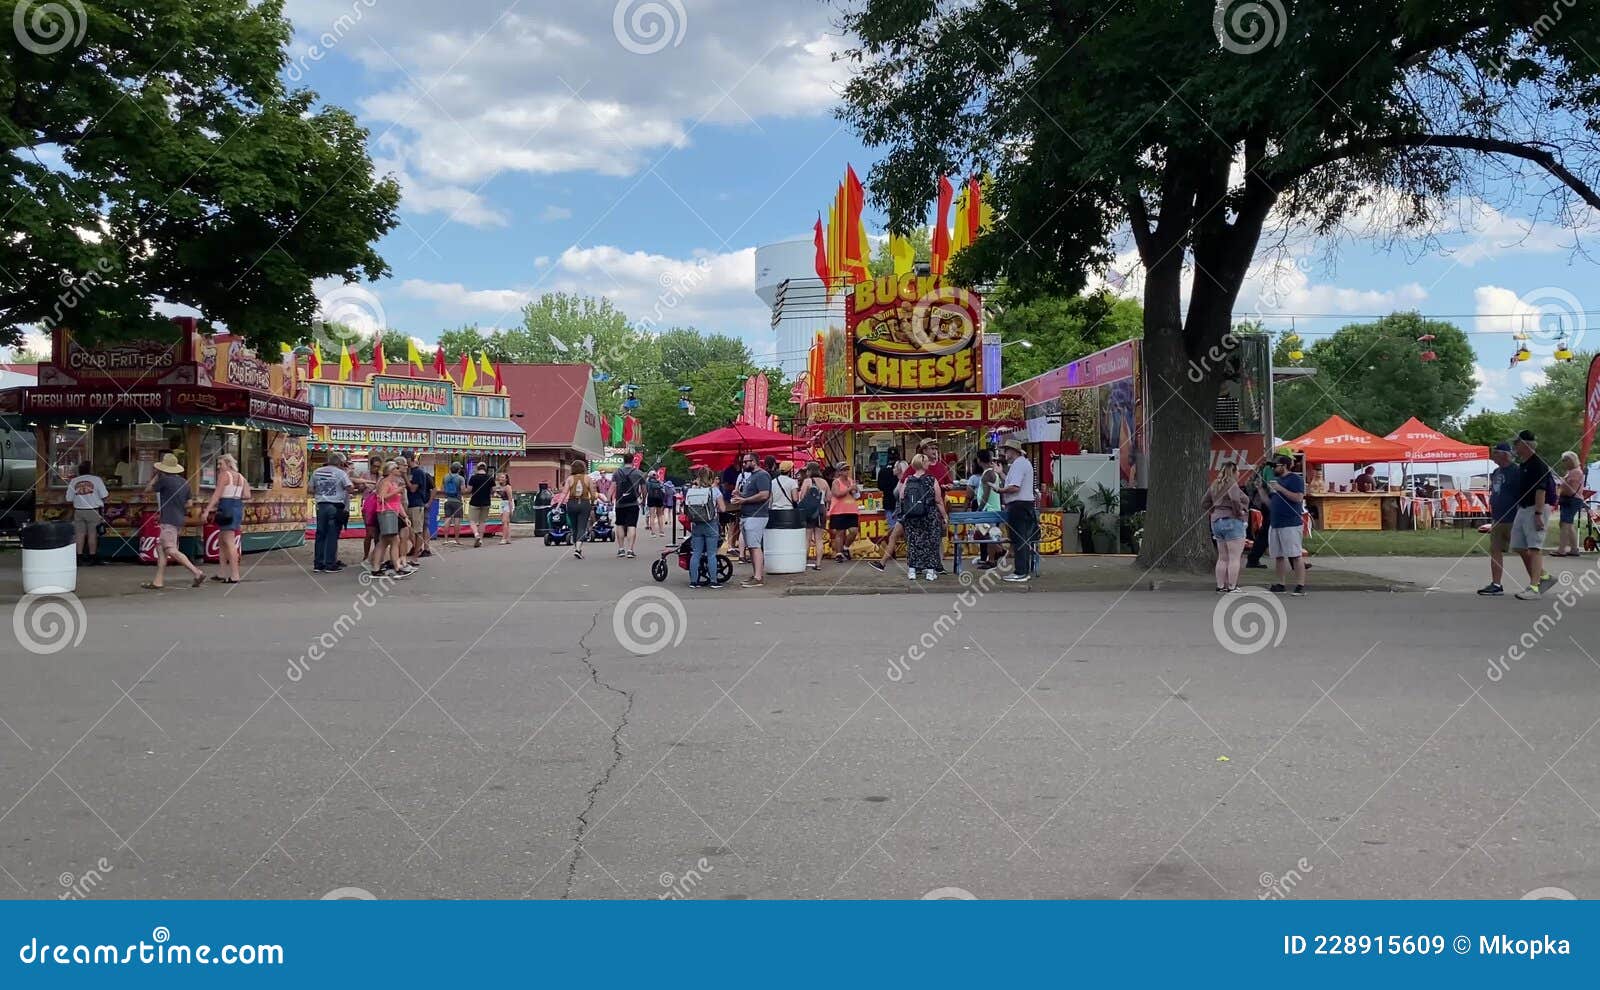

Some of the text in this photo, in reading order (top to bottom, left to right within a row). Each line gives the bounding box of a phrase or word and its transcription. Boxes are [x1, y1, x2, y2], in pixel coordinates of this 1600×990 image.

[70, 352, 174, 368] CRAB FRITTERS
[228, 361, 244, 382] CRAB
[857, 348, 973, 389] CHEESE
[30, 392, 161, 408] FRESH HOT CRAB FRITTERS
[378, 383, 447, 405] QUESADILLA
[387, 400, 438, 411] JUNCTION
[890, 402, 950, 410] ORIGINAL
[866, 410, 975, 420] CHEESE CURDS
[330, 429, 366, 441] CHEESE
[369, 430, 428, 444] QUESADILLAS
[436, 433, 521, 447] CHICKEN QUESADILLAS
[1324, 434, 1370, 444] STIHL
[1407, 432, 1440, 440] STIHL
[1209, 449, 1256, 471] IHL
[1331, 510, 1377, 522] STIHL
